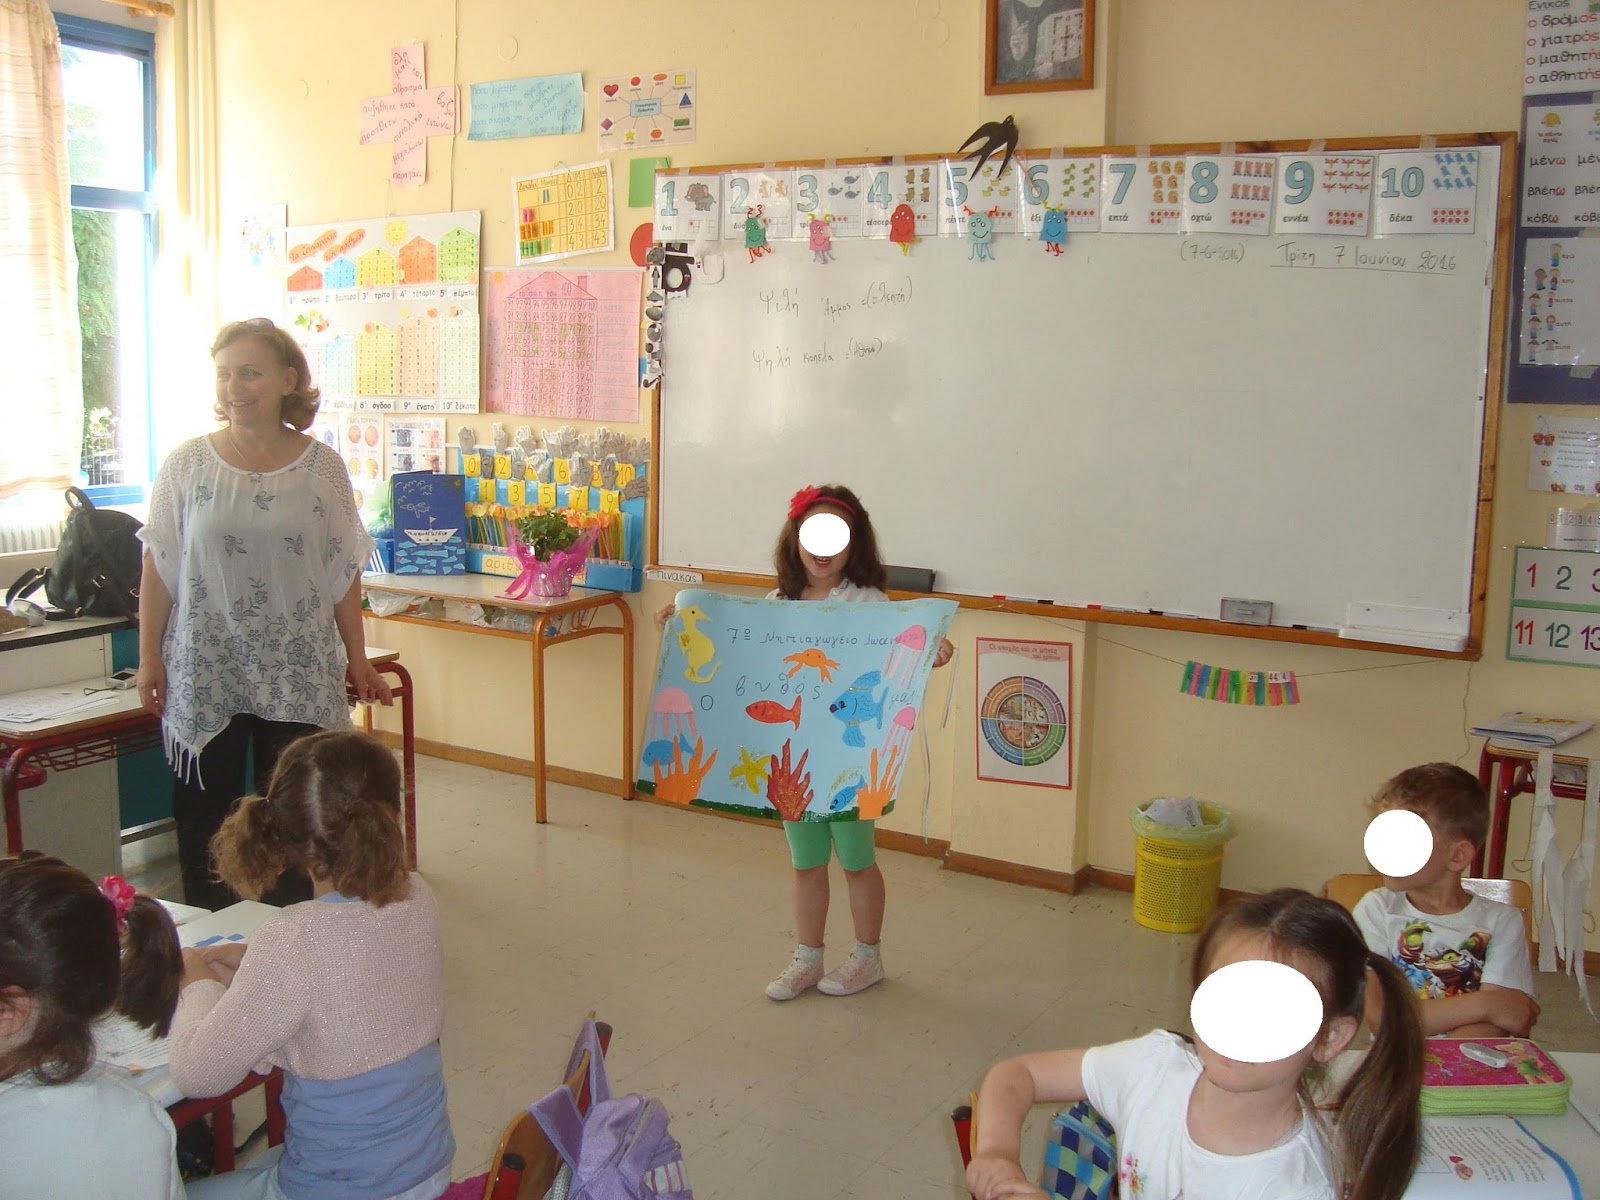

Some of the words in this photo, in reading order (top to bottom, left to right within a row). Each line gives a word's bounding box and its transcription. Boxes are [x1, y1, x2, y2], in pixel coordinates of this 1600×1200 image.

[1541, 14, 1597, 28] δρόμος
[1541, 30, 1599, 48] γιατρός
[1530, 155, 1566, 168] μένω
[867, 172, 892, 209] 4
[945, 167, 968, 207] 5
[1023, 165, 1050, 205] 6
[1109, 164, 1136, 204] 7
[1188, 161, 1219, 204] 8
[1284, 161, 1315, 204] 9
[1381, 167, 1424, 198] 10
[660, 180, 678, 216] 1
[729, 178, 750, 214] 2
[797, 174, 820, 212] 3
[1528, 186, 1566, 198] βλέπω
[594, 195, 607, 211] 20
[594, 214, 606, 229] 34
[945, 216, 966, 224] πέντε
[1030, 213, 1042, 223] έξι
[1108, 214, 1129, 222] επτά
[1190, 214, 1212, 222] οχτώ
[1282, 214, 1309, 222] εννέα
[1389, 213, 1413, 222] δέκα
[1527, 213, 1559, 223] κόβω
[594, 230, 606, 246] 43
[1334, 246, 1345, 265] 7
[1416, 250, 1456, 271] 2016
[374, 290, 391, 300] τρίτο
[412, 288, 436, 299] τέταρτο
[372, 401, 392, 411] όγδοο
[416, 402, 435, 411] ένατο
[468, 457, 477, 474] 0
[498, 457, 507, 475] 2
[558, 461, 567, 480] 6
[620, 466, 632, 485] 10
[484, 479, 488, 500] 1
[513, 484, 520, 502] 3
[543, 486, 552, 505] 5
[575, 489, 583, 507] 7
[606, 493, 614, 514] 9
[1527, 563, 1537, 588] 1
[1556, 565, 1572, 590] 2
[1515, 619, 1534, 646] 11
[1545, 621, 1571, 648] 12
